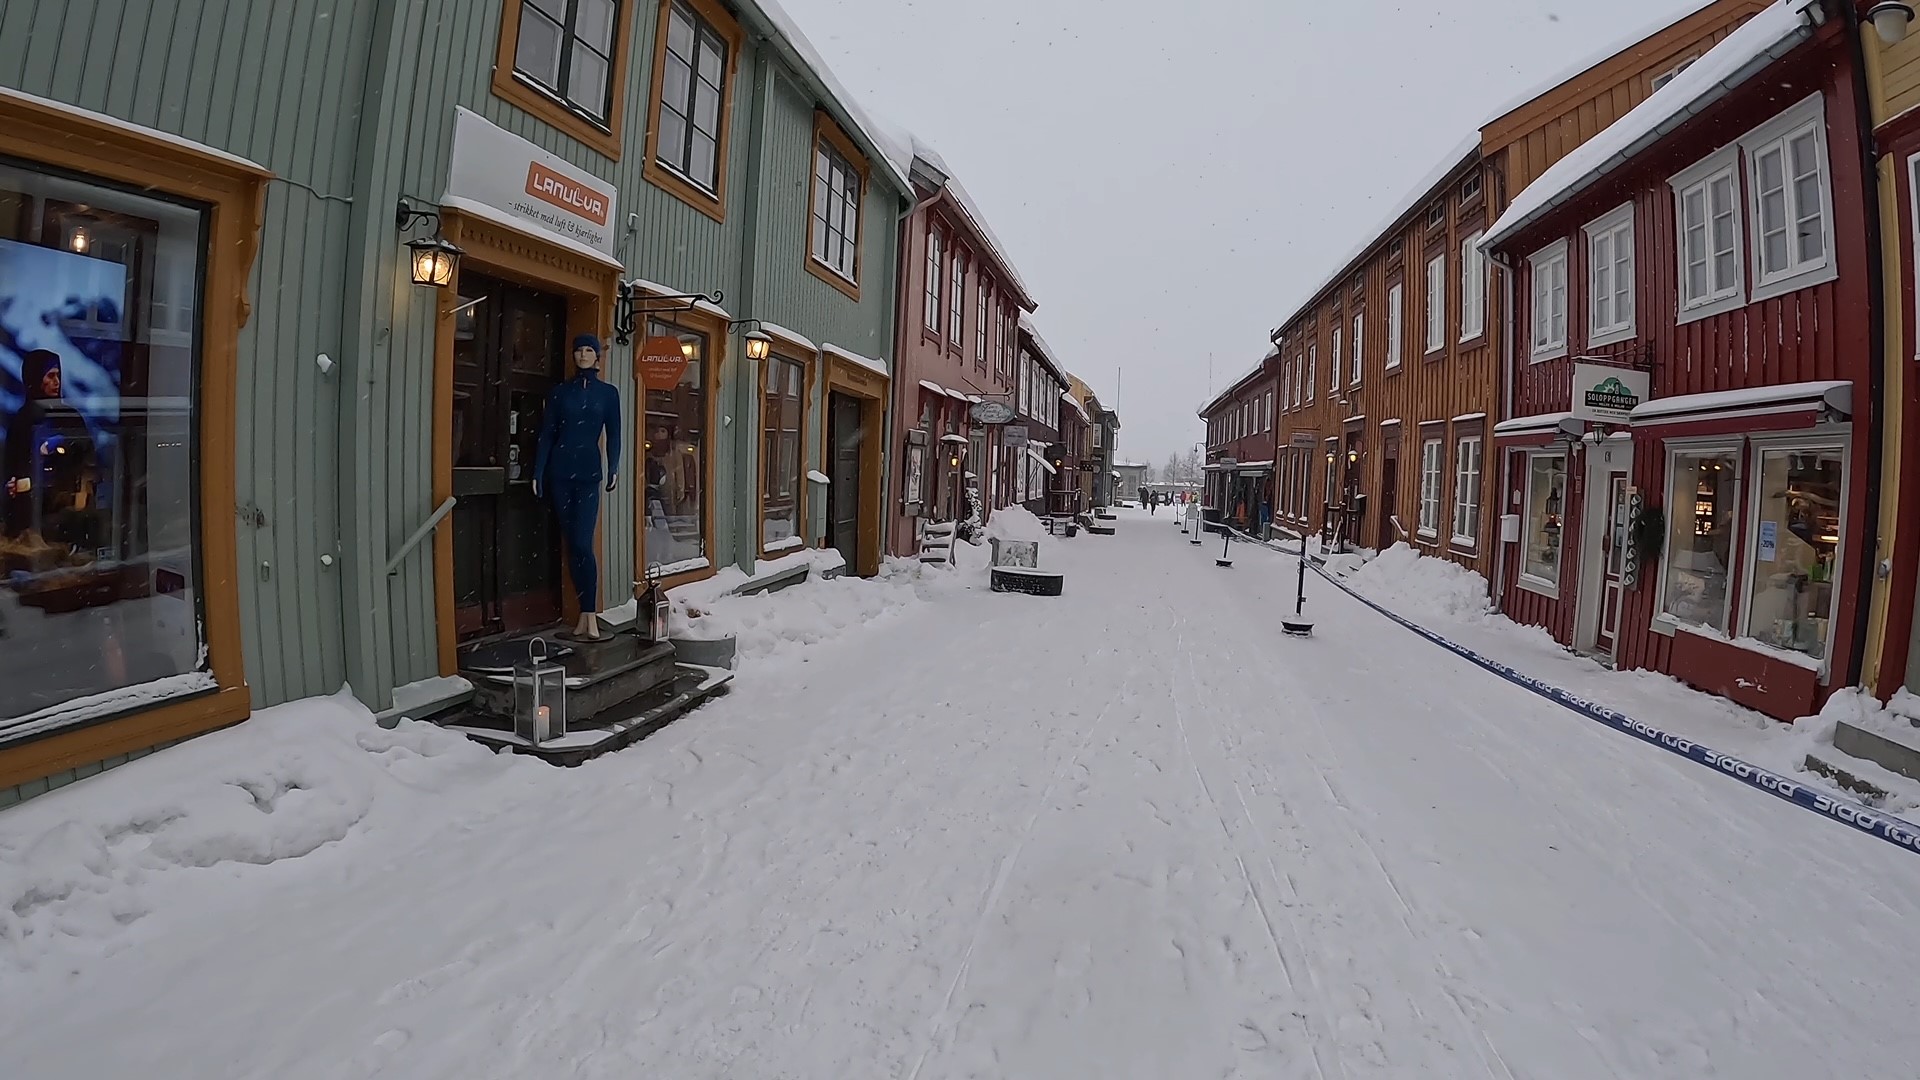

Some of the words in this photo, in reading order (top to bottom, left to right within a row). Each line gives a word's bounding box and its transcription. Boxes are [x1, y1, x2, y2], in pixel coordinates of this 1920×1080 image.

[513, 203, 540, 219] strikket
[540, 214, 554, 224] med
[554, 216, 567, 232] luft
[567, 220, 576, 232] &
